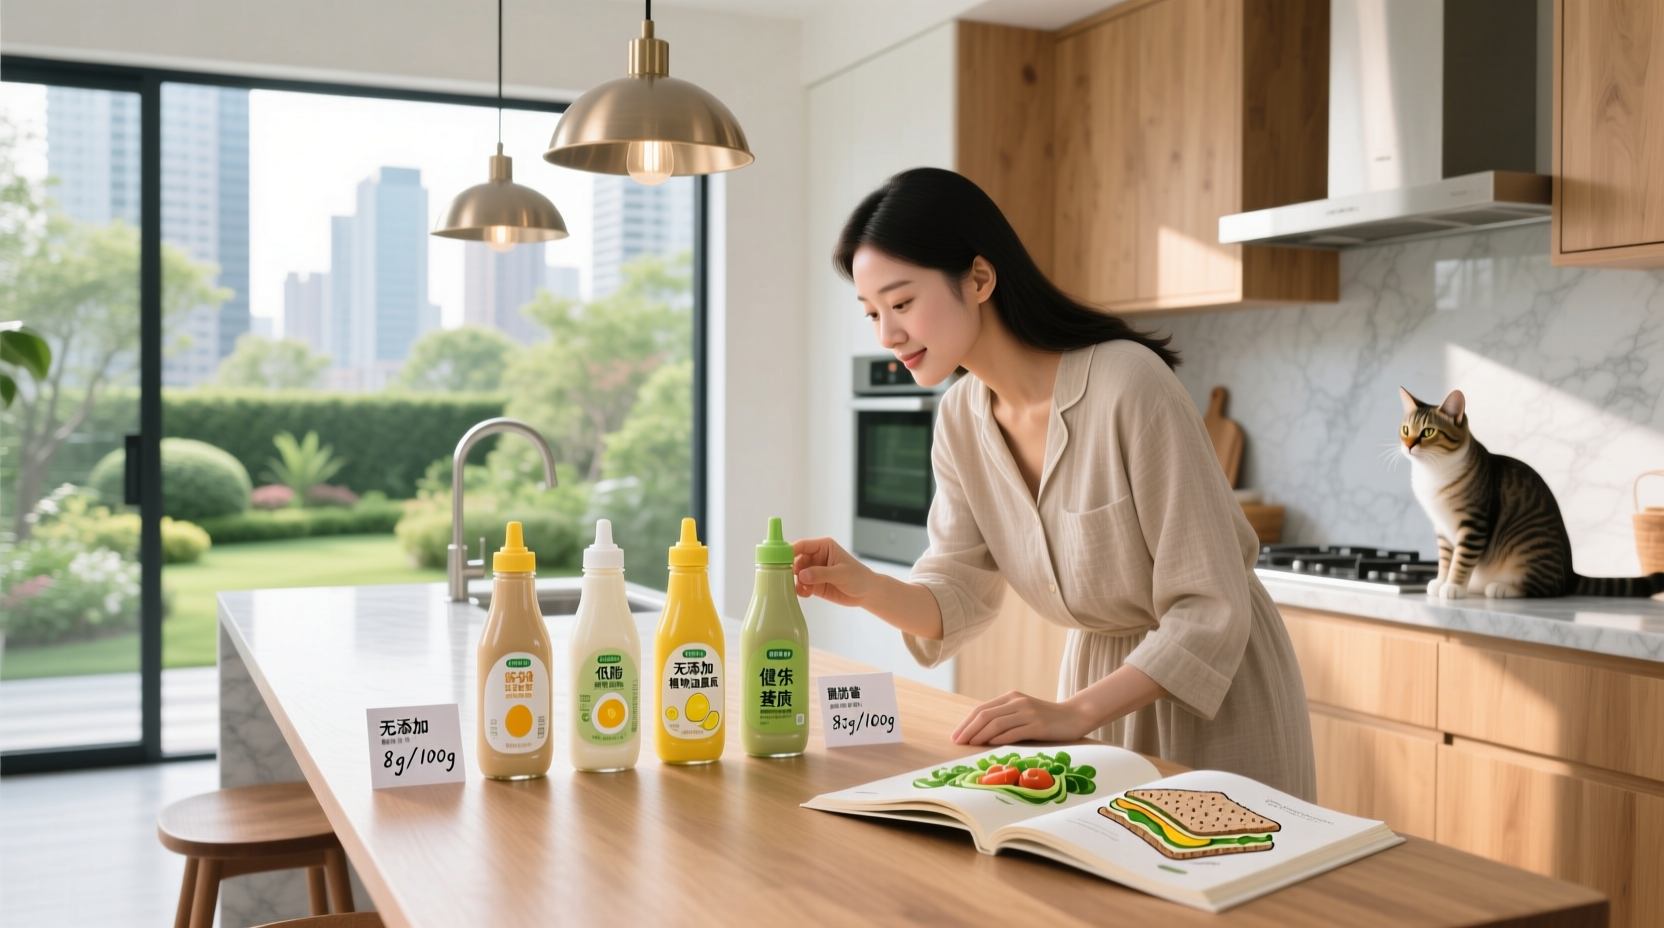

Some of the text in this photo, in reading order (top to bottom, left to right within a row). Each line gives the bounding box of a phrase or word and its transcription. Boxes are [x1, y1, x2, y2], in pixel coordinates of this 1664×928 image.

[379, 717, 429, 737] 无添加
[383, 746, 456, 777] 8g/100g
